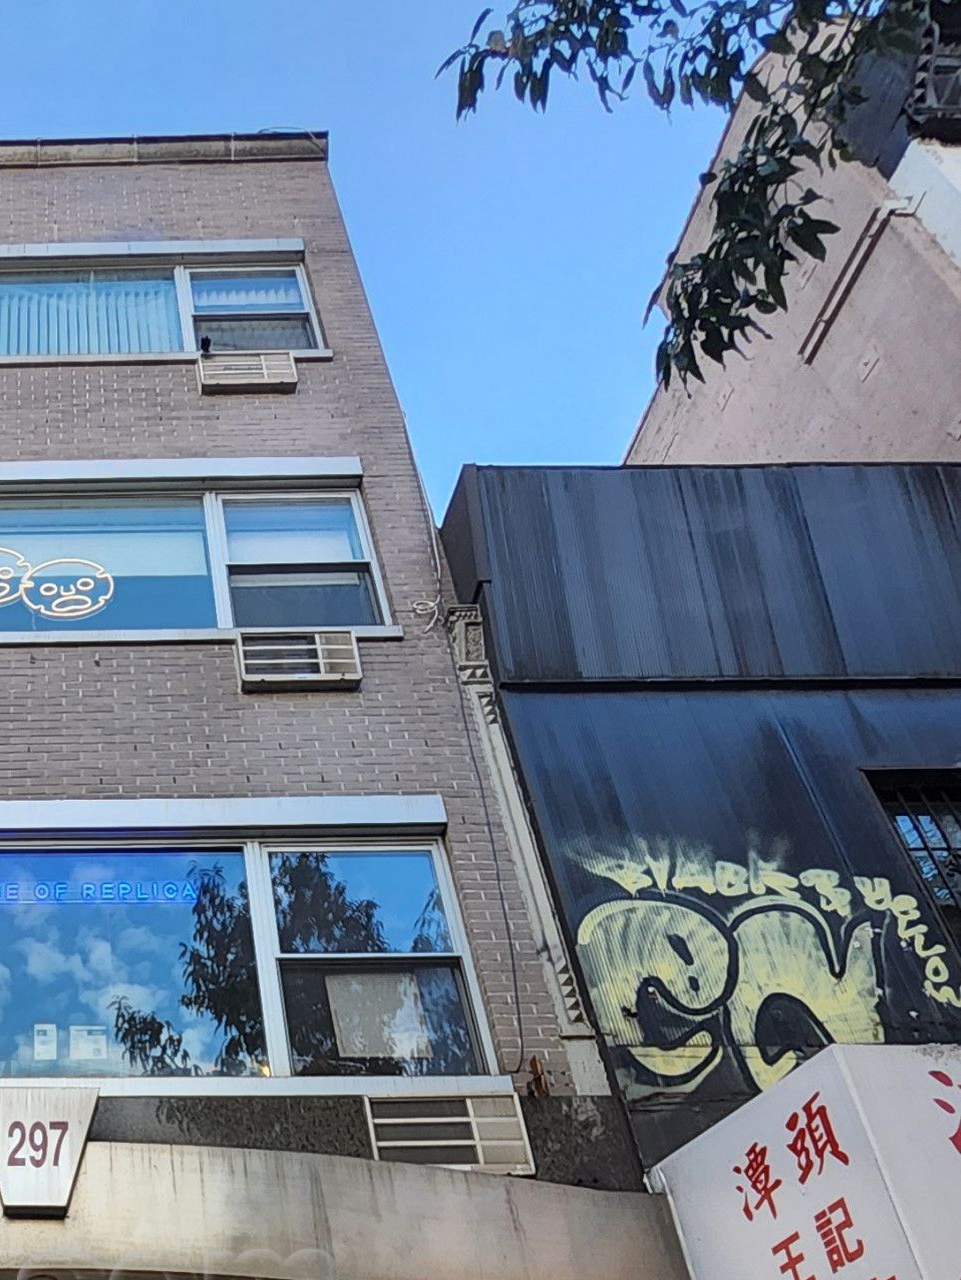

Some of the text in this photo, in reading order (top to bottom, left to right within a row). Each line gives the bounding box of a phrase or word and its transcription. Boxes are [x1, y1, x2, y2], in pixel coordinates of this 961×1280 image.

[34, 881, 69, 899] OF
[81, 881, 199, 899] REPLICA
[7, 1120, 69, 1168] 297
[732, 1091, 850, 1222] 潭頭
